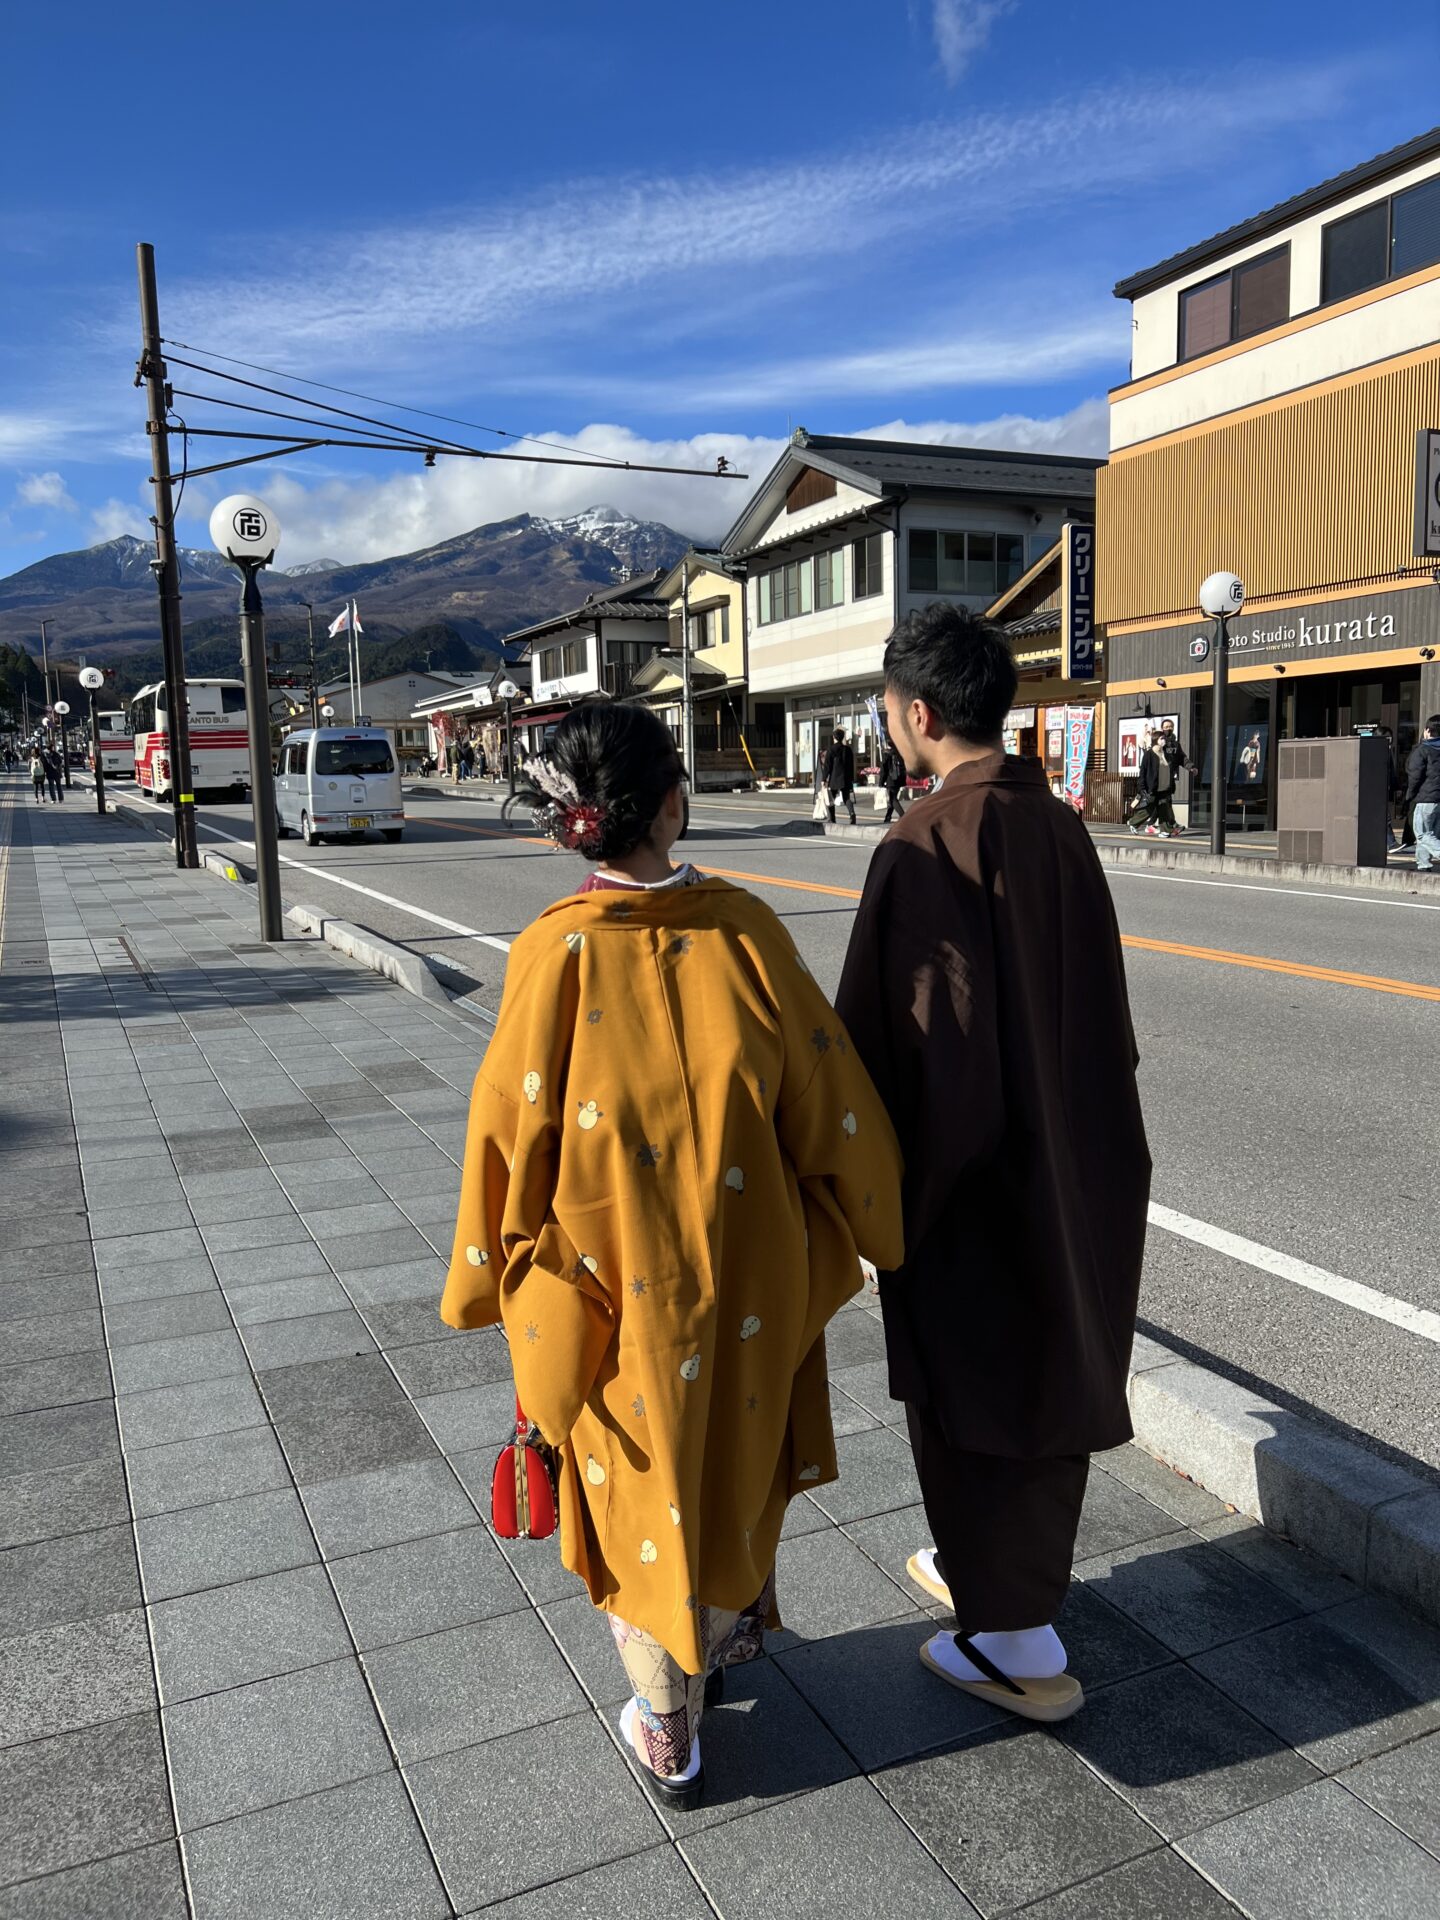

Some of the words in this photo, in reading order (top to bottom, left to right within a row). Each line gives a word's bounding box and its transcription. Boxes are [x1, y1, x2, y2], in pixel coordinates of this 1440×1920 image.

[1075, 532, 1094, 659] クリーニング
[1228, 634, 1249, 648] oto
[1252, 625, 1296, 645] Studio
[1299, 611, 1396, 648] kurata
[213, 716, 230, 724] BUS
